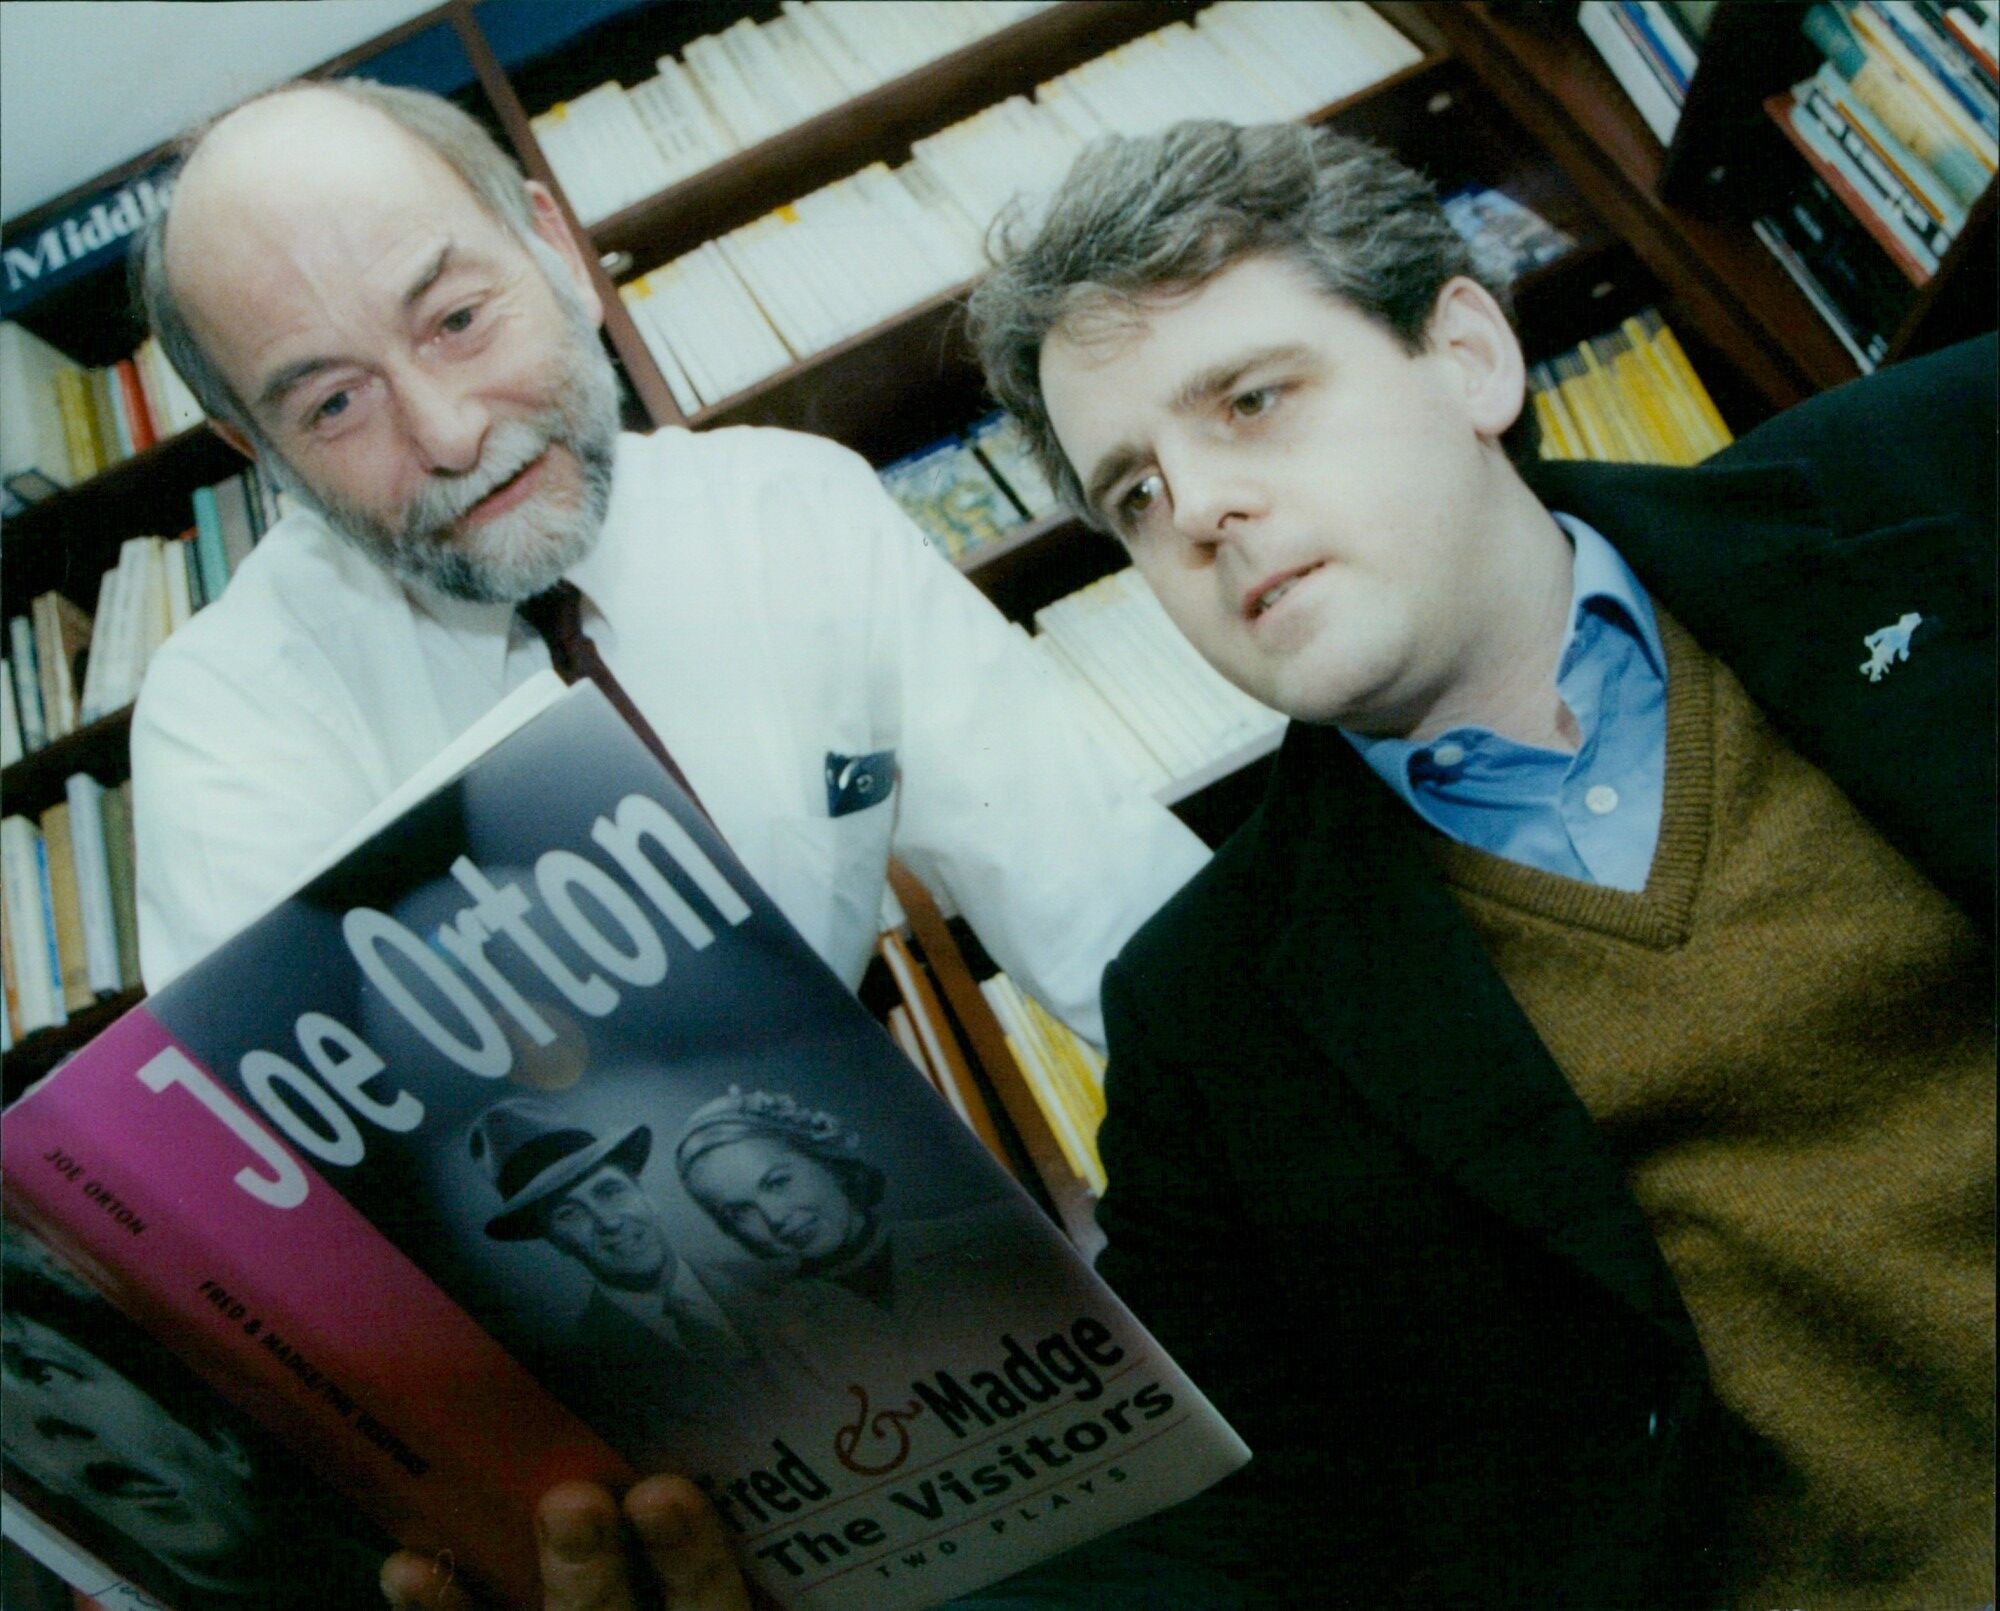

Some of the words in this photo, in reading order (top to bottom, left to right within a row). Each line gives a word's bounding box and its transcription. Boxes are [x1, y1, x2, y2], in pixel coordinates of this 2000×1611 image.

[136, 1012, 425, 1209] Joe
[343, 794, 752, 1079] Orton
[43, 1147, 83, 1184] JOE
[83, 1180, 146, 1238] ORTON
[200, 1280, 246, 1322] FRED
[833, 1383, 924, 1477] &
[911, 1315, 1126, 1439] Madge
[757, 1513, 886, 1578] The
[891, 1381, 1176, 1522] Visitors
[875, 1539, 959, 1581] TWO
[991, 1465, 1129, 1536] PLAYS
